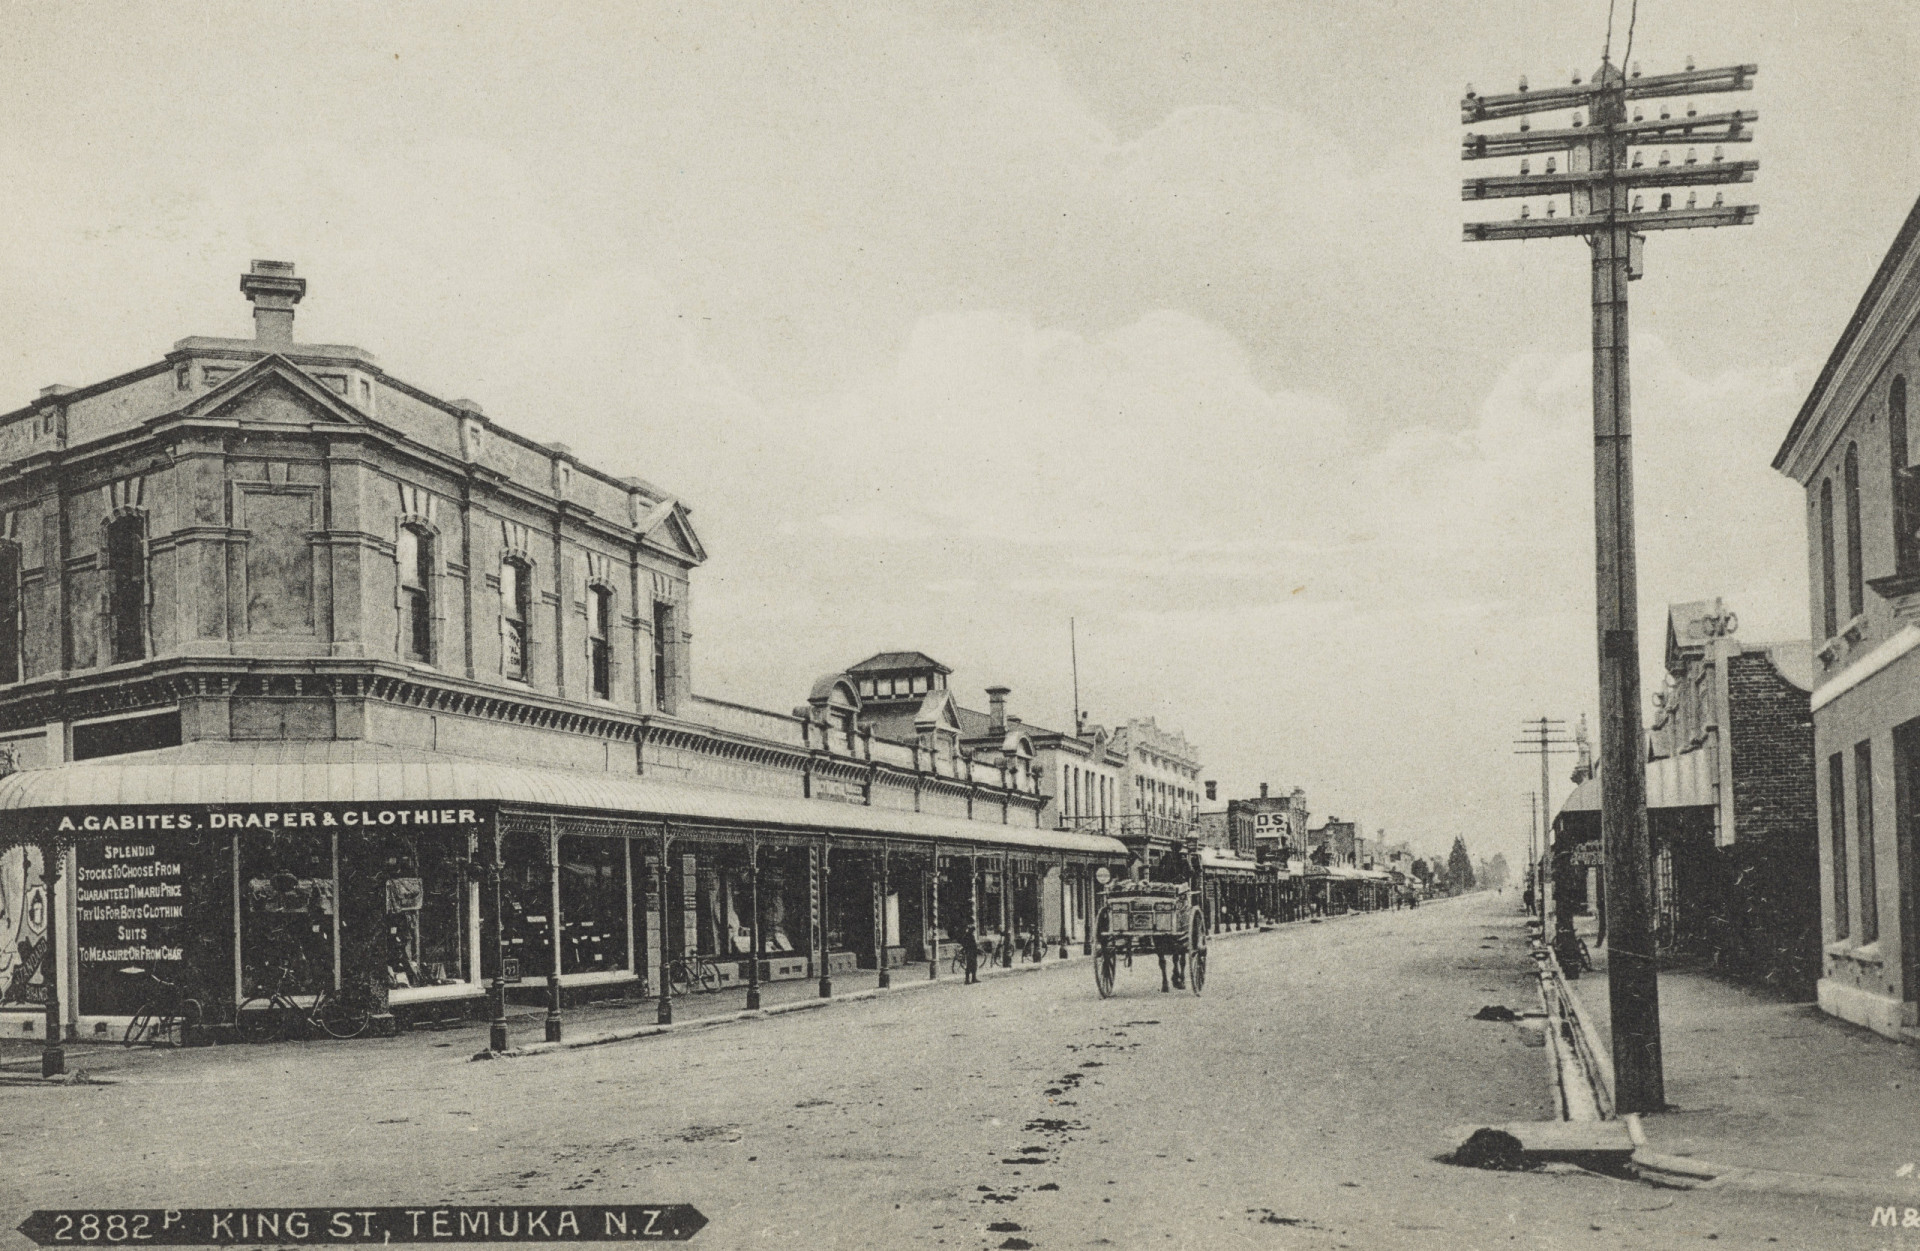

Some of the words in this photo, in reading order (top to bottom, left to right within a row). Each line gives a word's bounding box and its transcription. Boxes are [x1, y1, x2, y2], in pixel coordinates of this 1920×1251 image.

[210, 812, 317, 829] DRAPER
[322, 811, 338, 826] &
[343, 809, 485, 826] CLOTHIER.
[104, 844, 155, 859] SPLENDID
[122, 863, 154, 878] CHOOSE
[155, 861, 181, 877] FROM
[77, 887, 129, 901] GUARANTEED
[129, 884, 161, 899] TIMARU
[77, 907, 93, 921] TRY
[118, 925, 147, 941] SUITS
[89, 946, 129, 961] MEASURE
[140, 945, 161, 960] FROM
